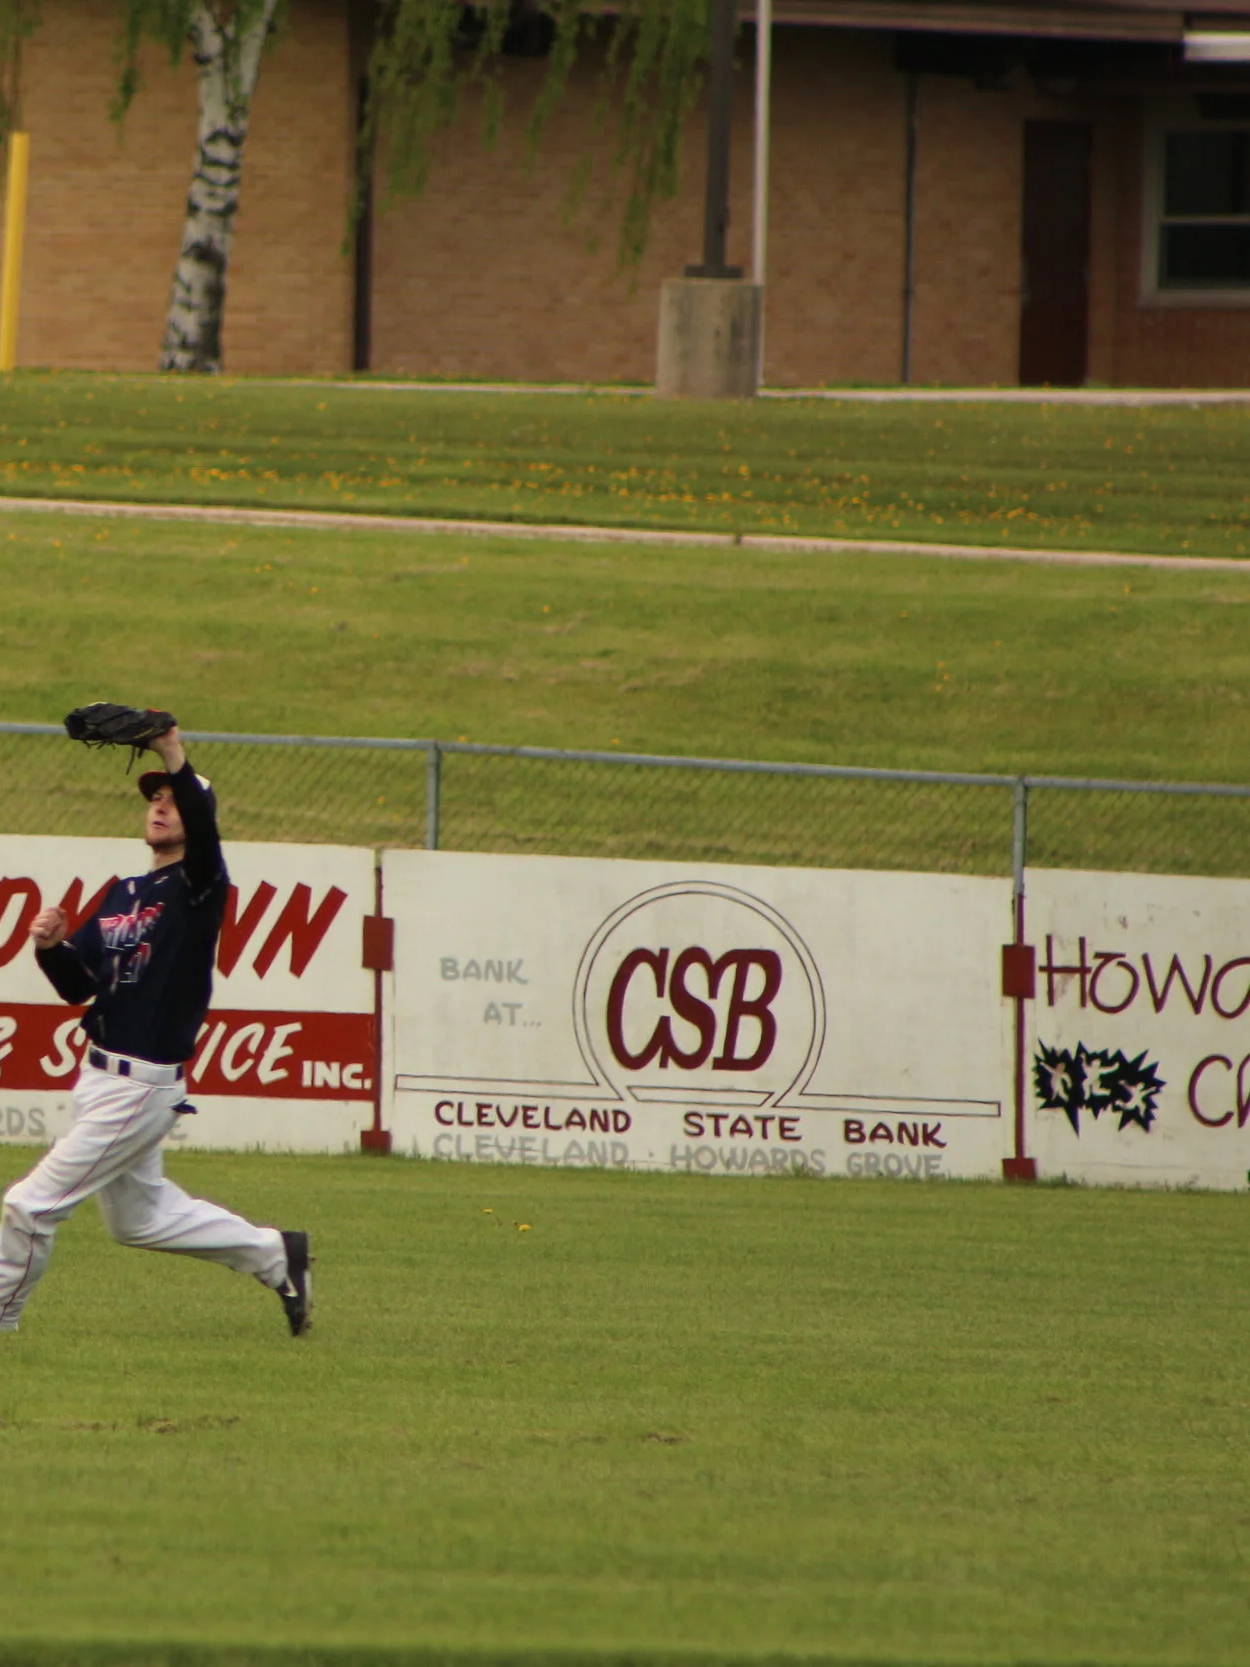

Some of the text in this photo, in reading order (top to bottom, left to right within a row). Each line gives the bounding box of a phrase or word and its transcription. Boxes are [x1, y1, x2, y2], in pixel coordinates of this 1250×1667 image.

[439, 957, 528, 985] BANK
[606, 946, 782, 1071] CSB
[40, 1018, 303, 1085] SICE
[302, 1059, 372, 1089] INC.
[434, 1101, 947, 1149] CLEVELAND STATE BANK
[432, 1133, 943, 1179] CLEVELAND HOWARDS GROVE
